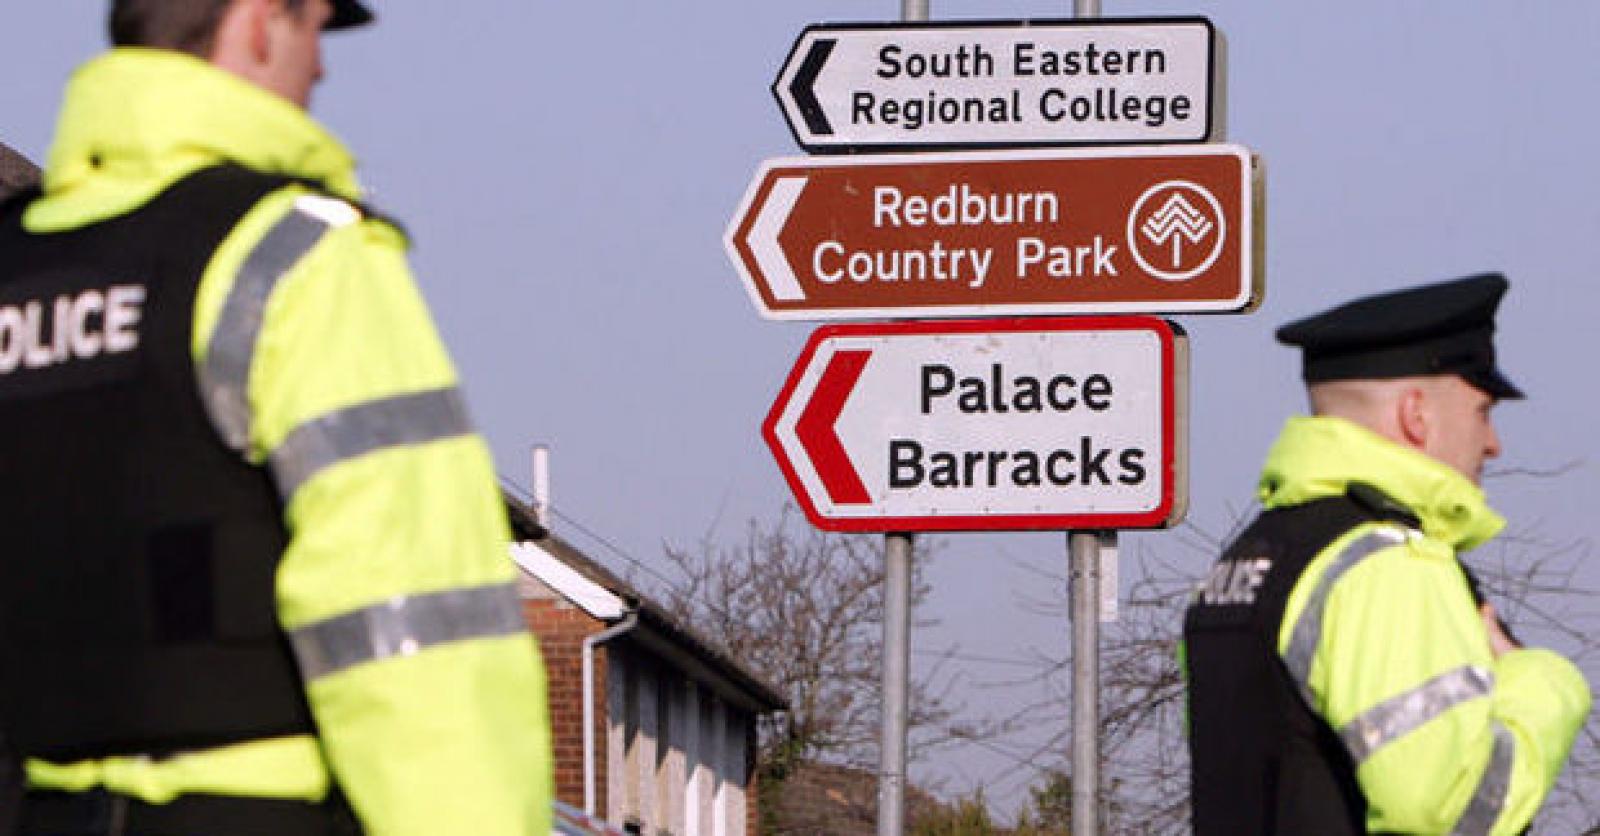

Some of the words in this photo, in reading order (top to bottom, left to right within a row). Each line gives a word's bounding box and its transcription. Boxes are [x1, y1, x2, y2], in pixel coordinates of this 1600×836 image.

[877, 45, 994, 77] South
[1013, 43, 1166, 74] Eastern
[851, 91, 1022, 128] Regional
[1039, 89, 1191, 126] College
[874, 184, 1059, 227] Redburn
[813, 239, 993, 288] Country
[1016, 236, 1118, 277] Park
[920, 363, 1113, 414] Palace
[888, 436, 1147, 488] Barracks
